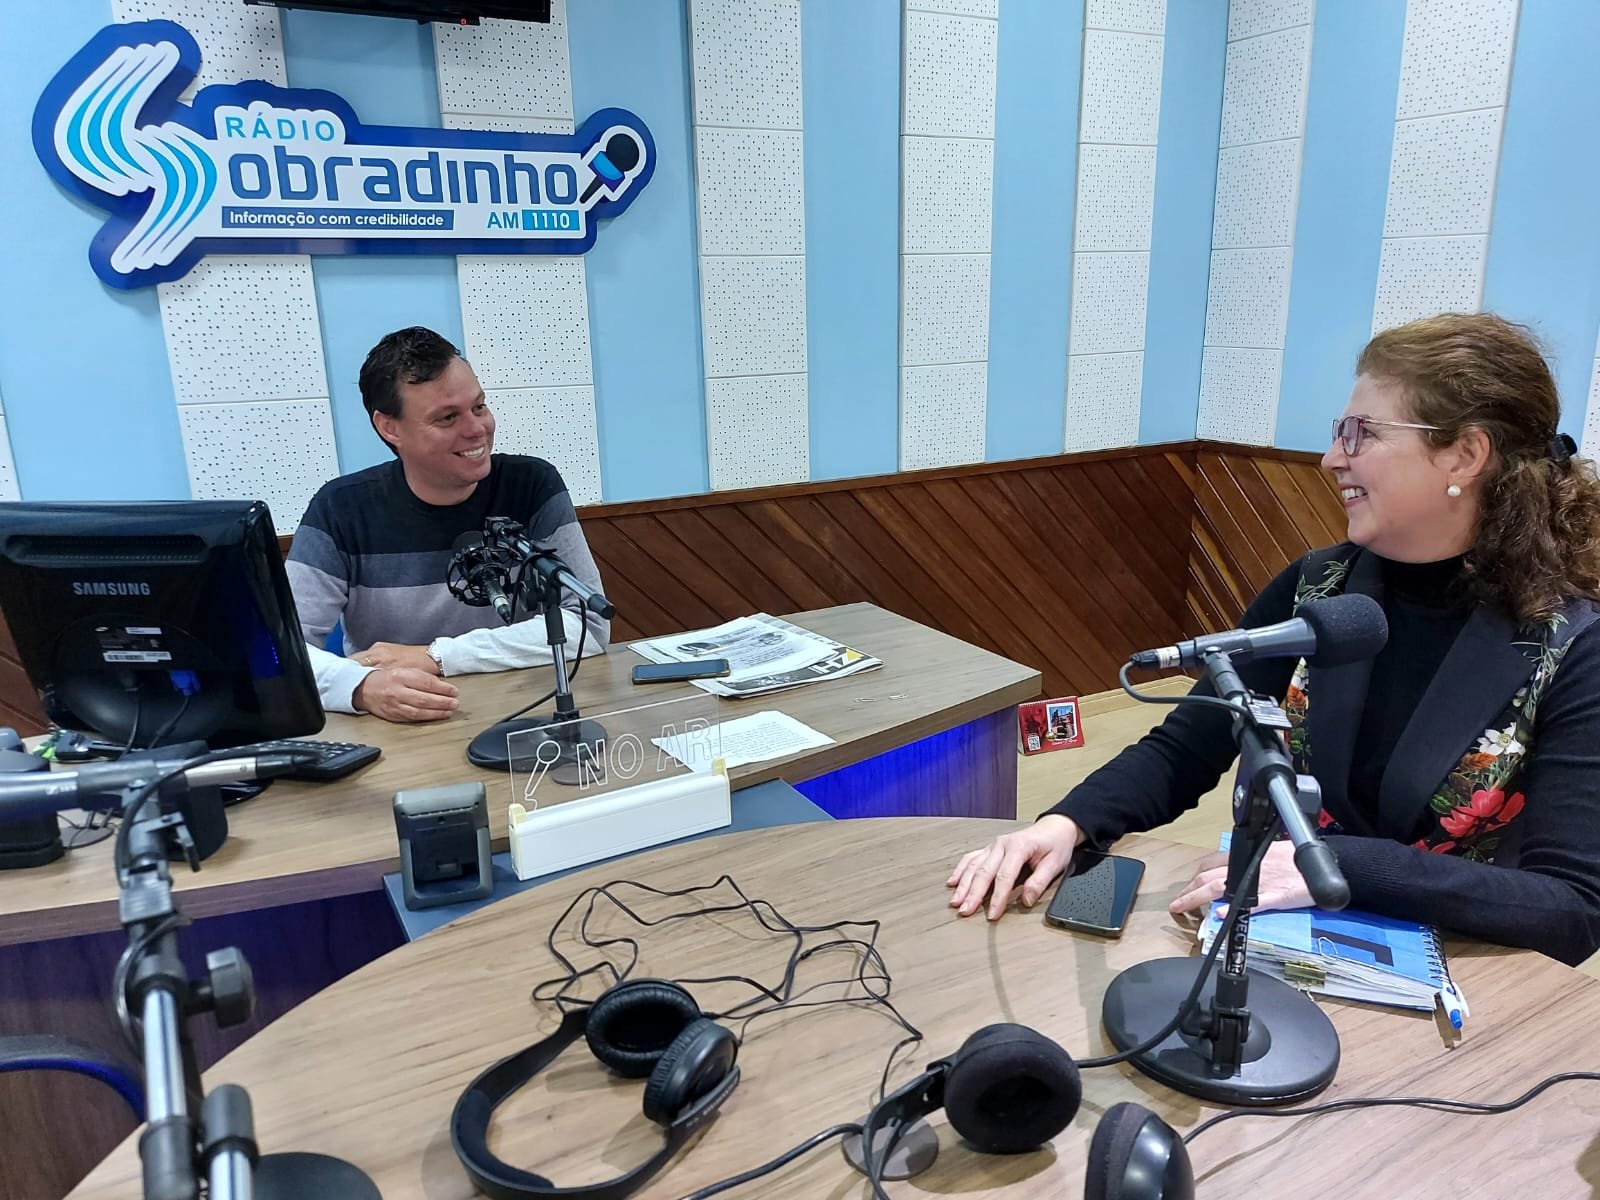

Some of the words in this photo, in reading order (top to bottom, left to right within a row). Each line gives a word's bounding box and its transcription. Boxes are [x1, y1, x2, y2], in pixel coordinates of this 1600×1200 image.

[225, 112, 335, 142] RÁDIO
[230, 211, 315, 226] Informação
[319, 214, 351, 225] com
[355, 213, 444, 226] credibilidade
[487, 212, 519, 229] AM
[532, 212, 570, 228] 1110
[72, 582, 151, 596] SAMSUNG
[576, 733, 645, 790] NO
[656, 717, 713, 772] AR
